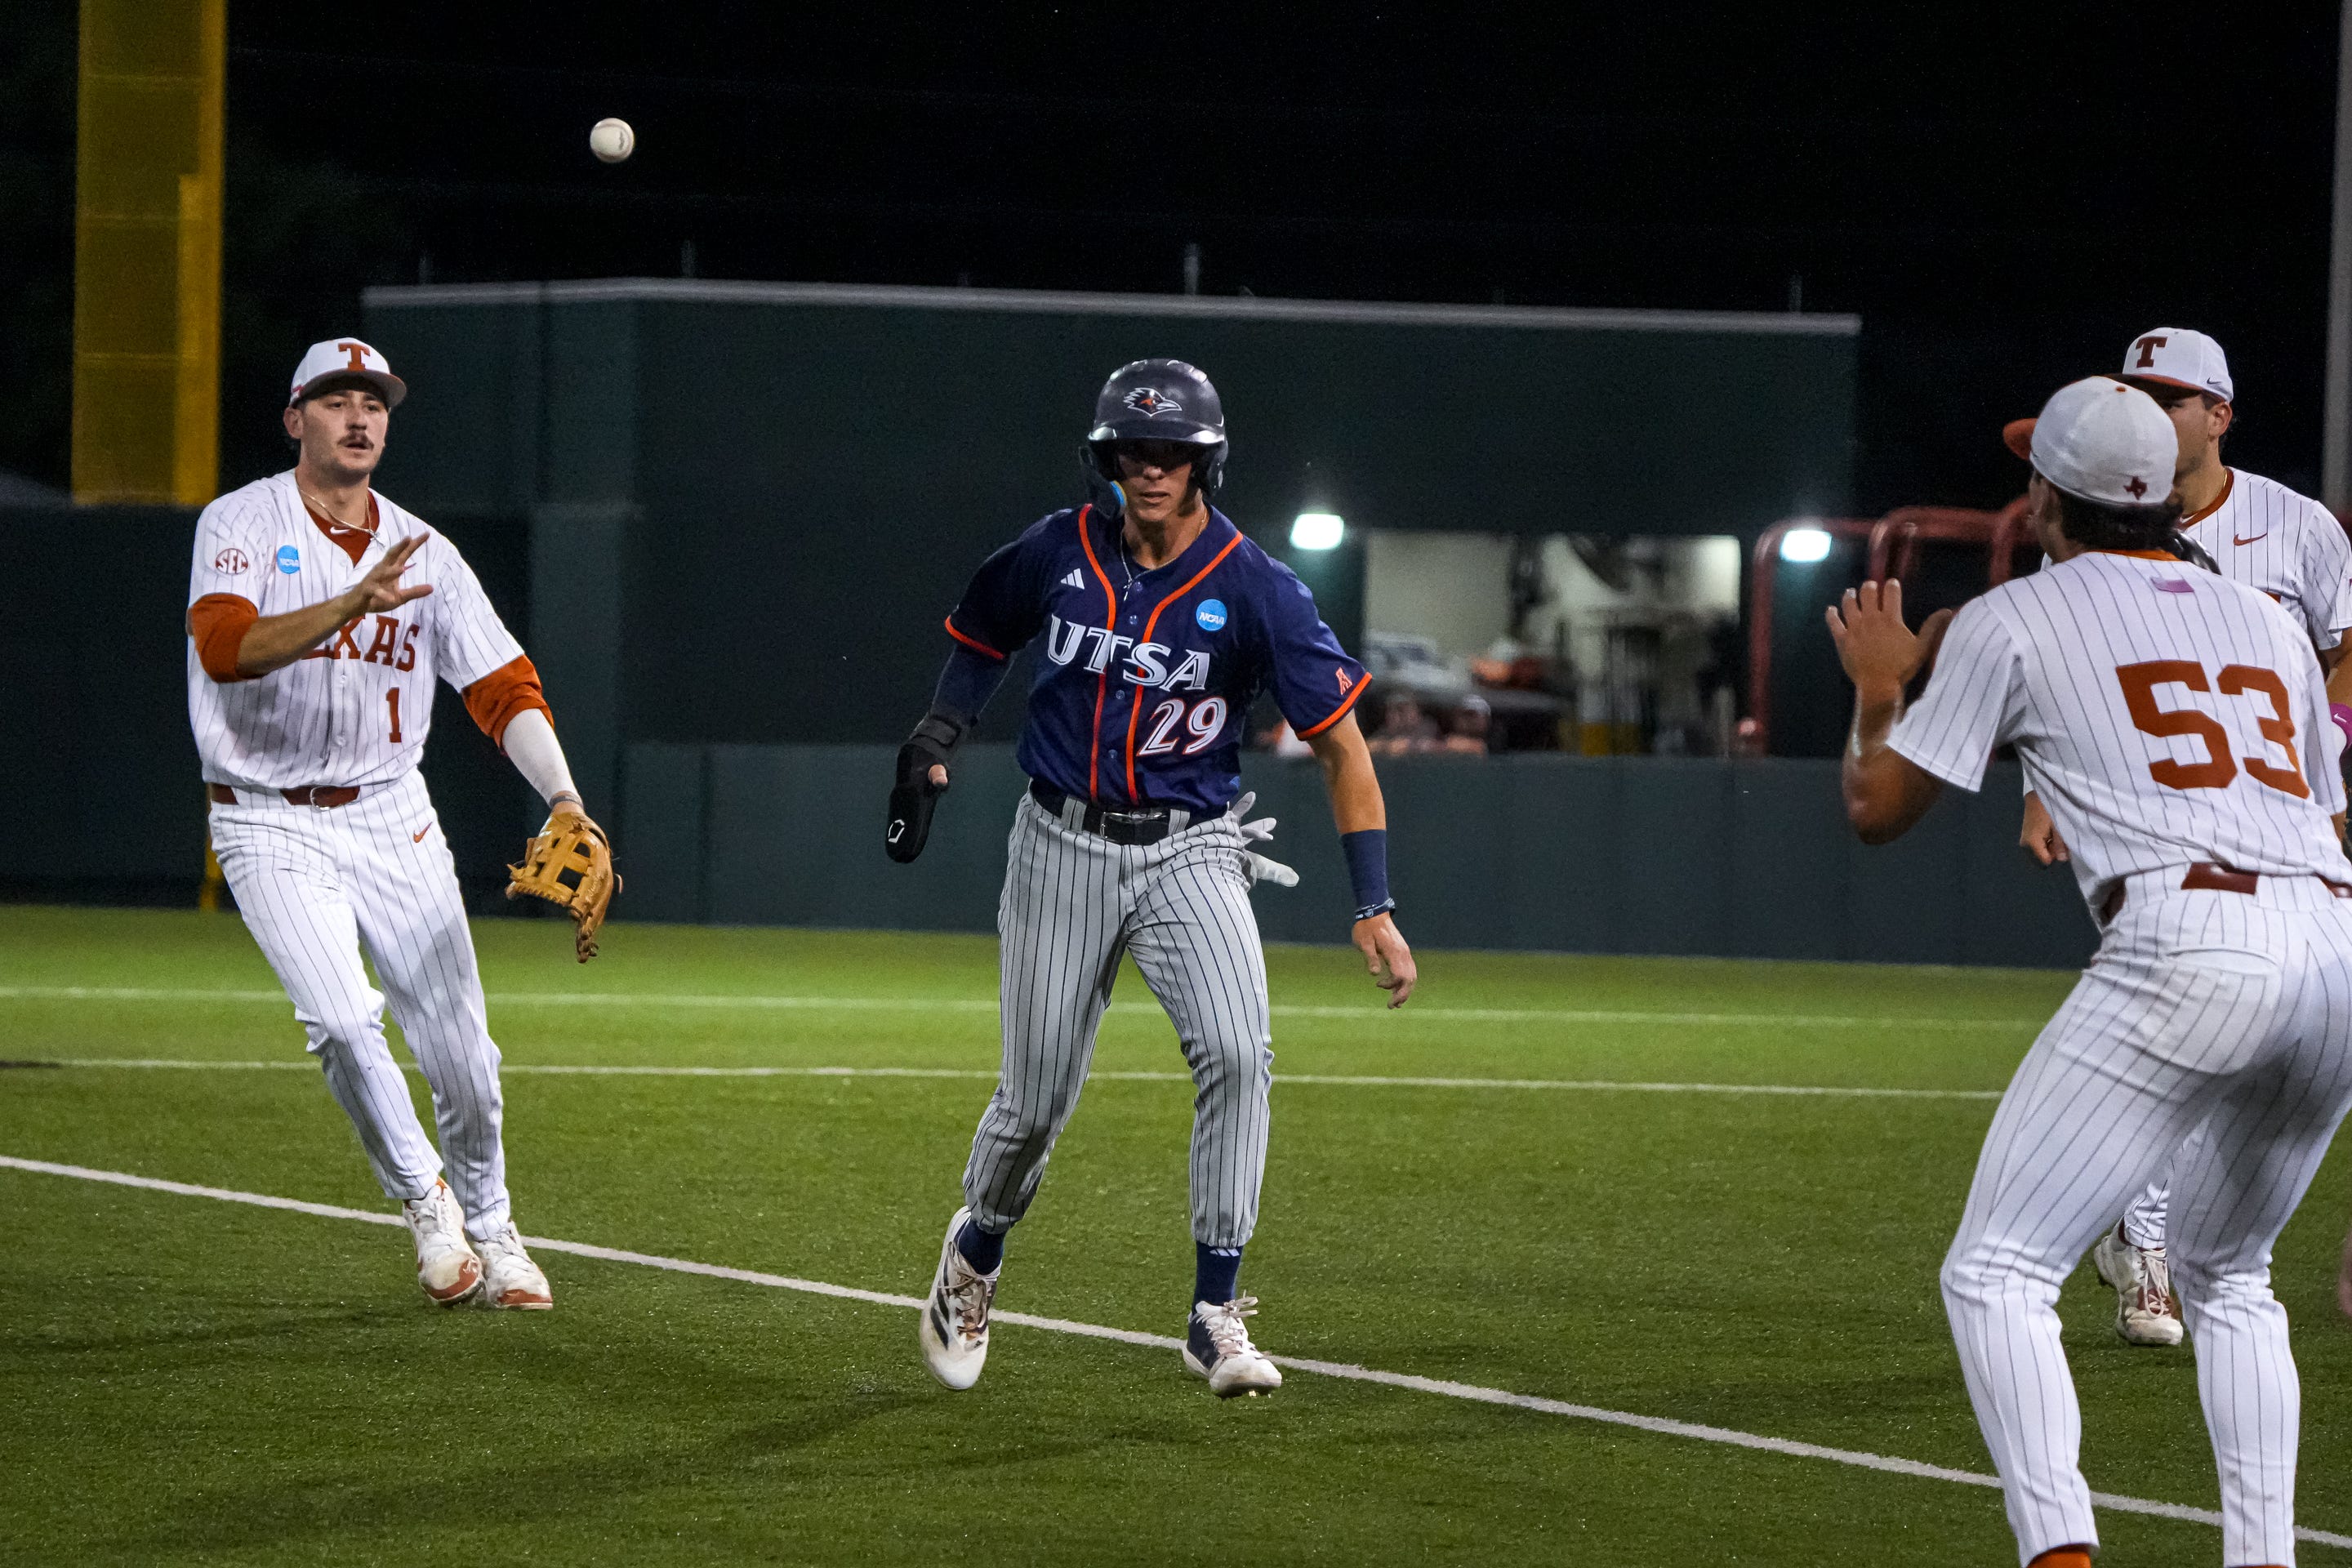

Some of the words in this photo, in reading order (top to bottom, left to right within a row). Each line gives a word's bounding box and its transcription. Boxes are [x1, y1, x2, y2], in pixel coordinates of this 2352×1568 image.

[338, 342, 370, 371] T
[2136, 336, 2168, 368] T
[216, 548, 248, 574] SEC
[1199, 612, 1225, 625] NCAA
[1048, 613, 1210, 692] UTSA
[385, 687, 402, 742] 1
[1136, 696, 1228, 756] 29
[2116, 660, 2310, 799] 53
